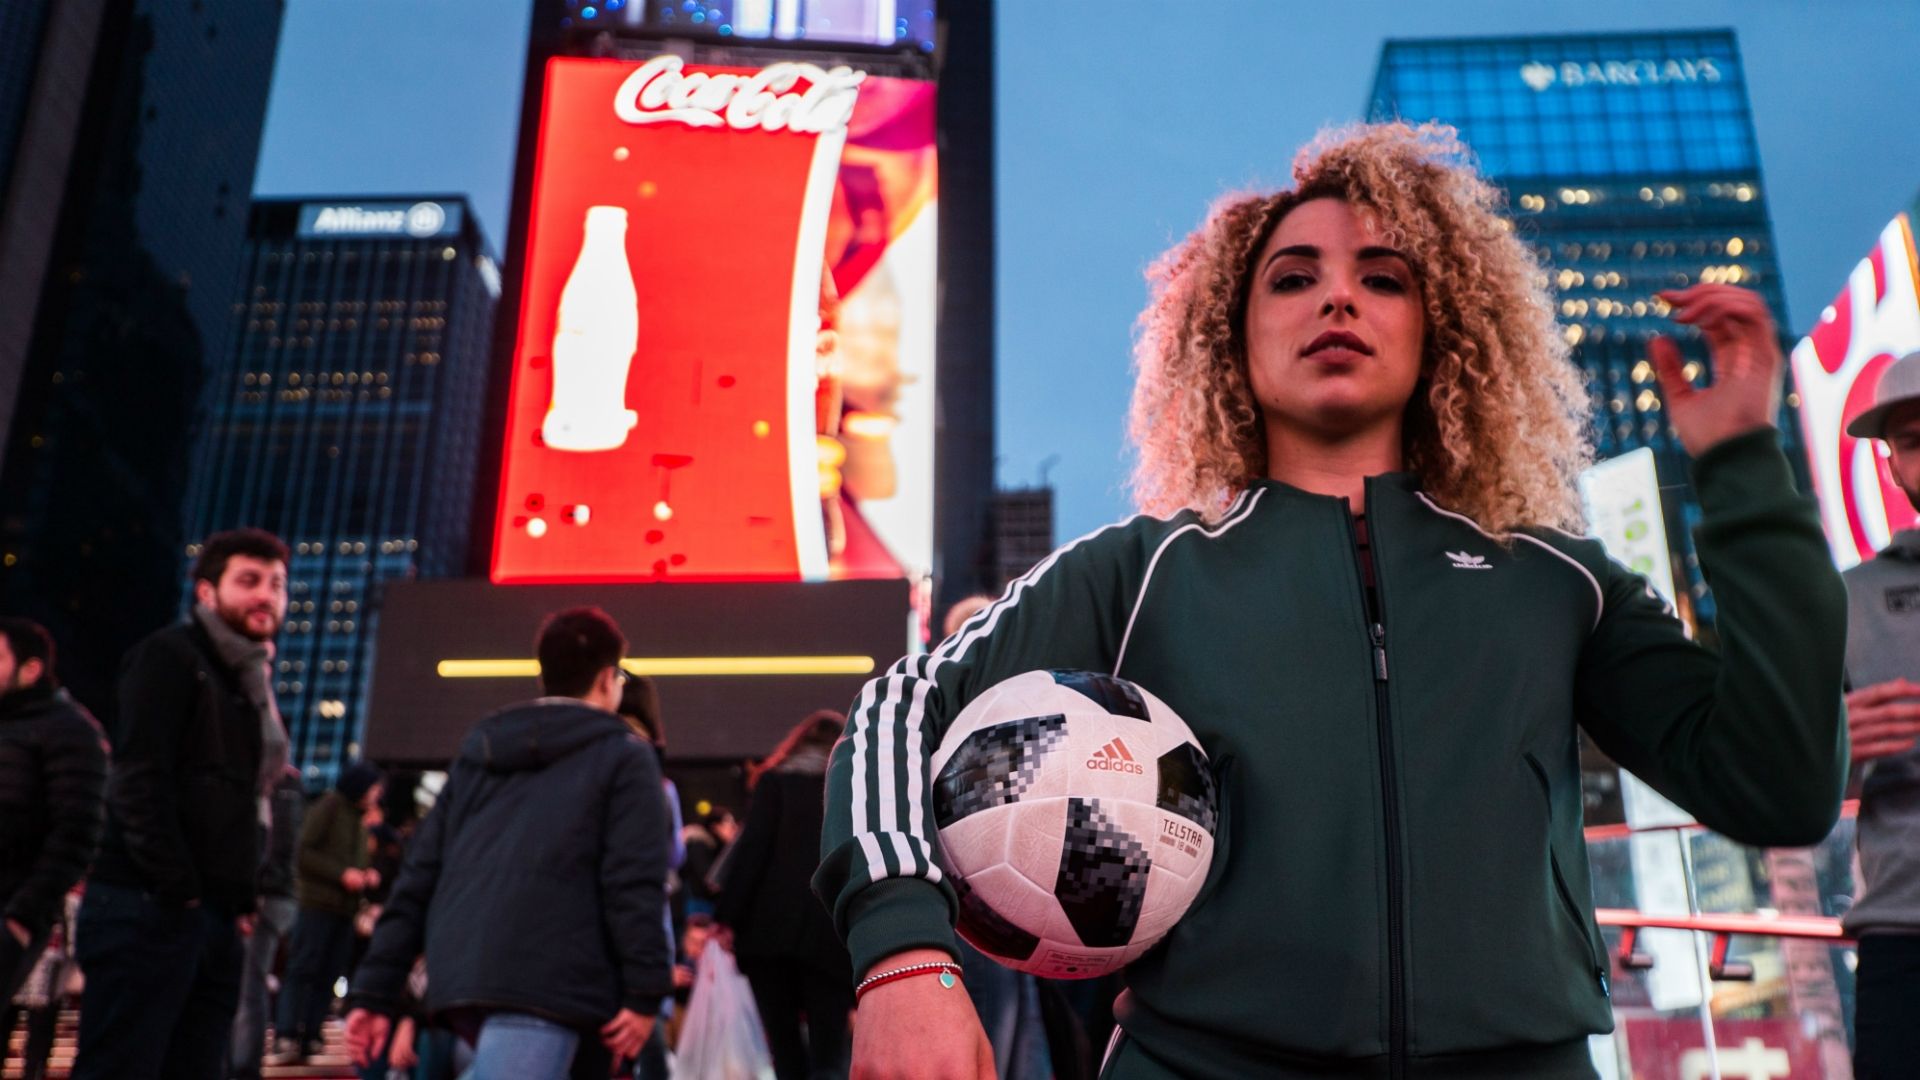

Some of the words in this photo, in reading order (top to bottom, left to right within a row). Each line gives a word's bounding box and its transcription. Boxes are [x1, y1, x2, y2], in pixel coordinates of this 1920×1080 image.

[1560, 57, 1721, 86] BARCLAYS
[614, 55, 867, 133] Coca-Cola
[313, 206, 404, 233] Allianz
[1086, 757, 1143, 775] adidas
[1163, 818, 1203, 848] TELSTAR
